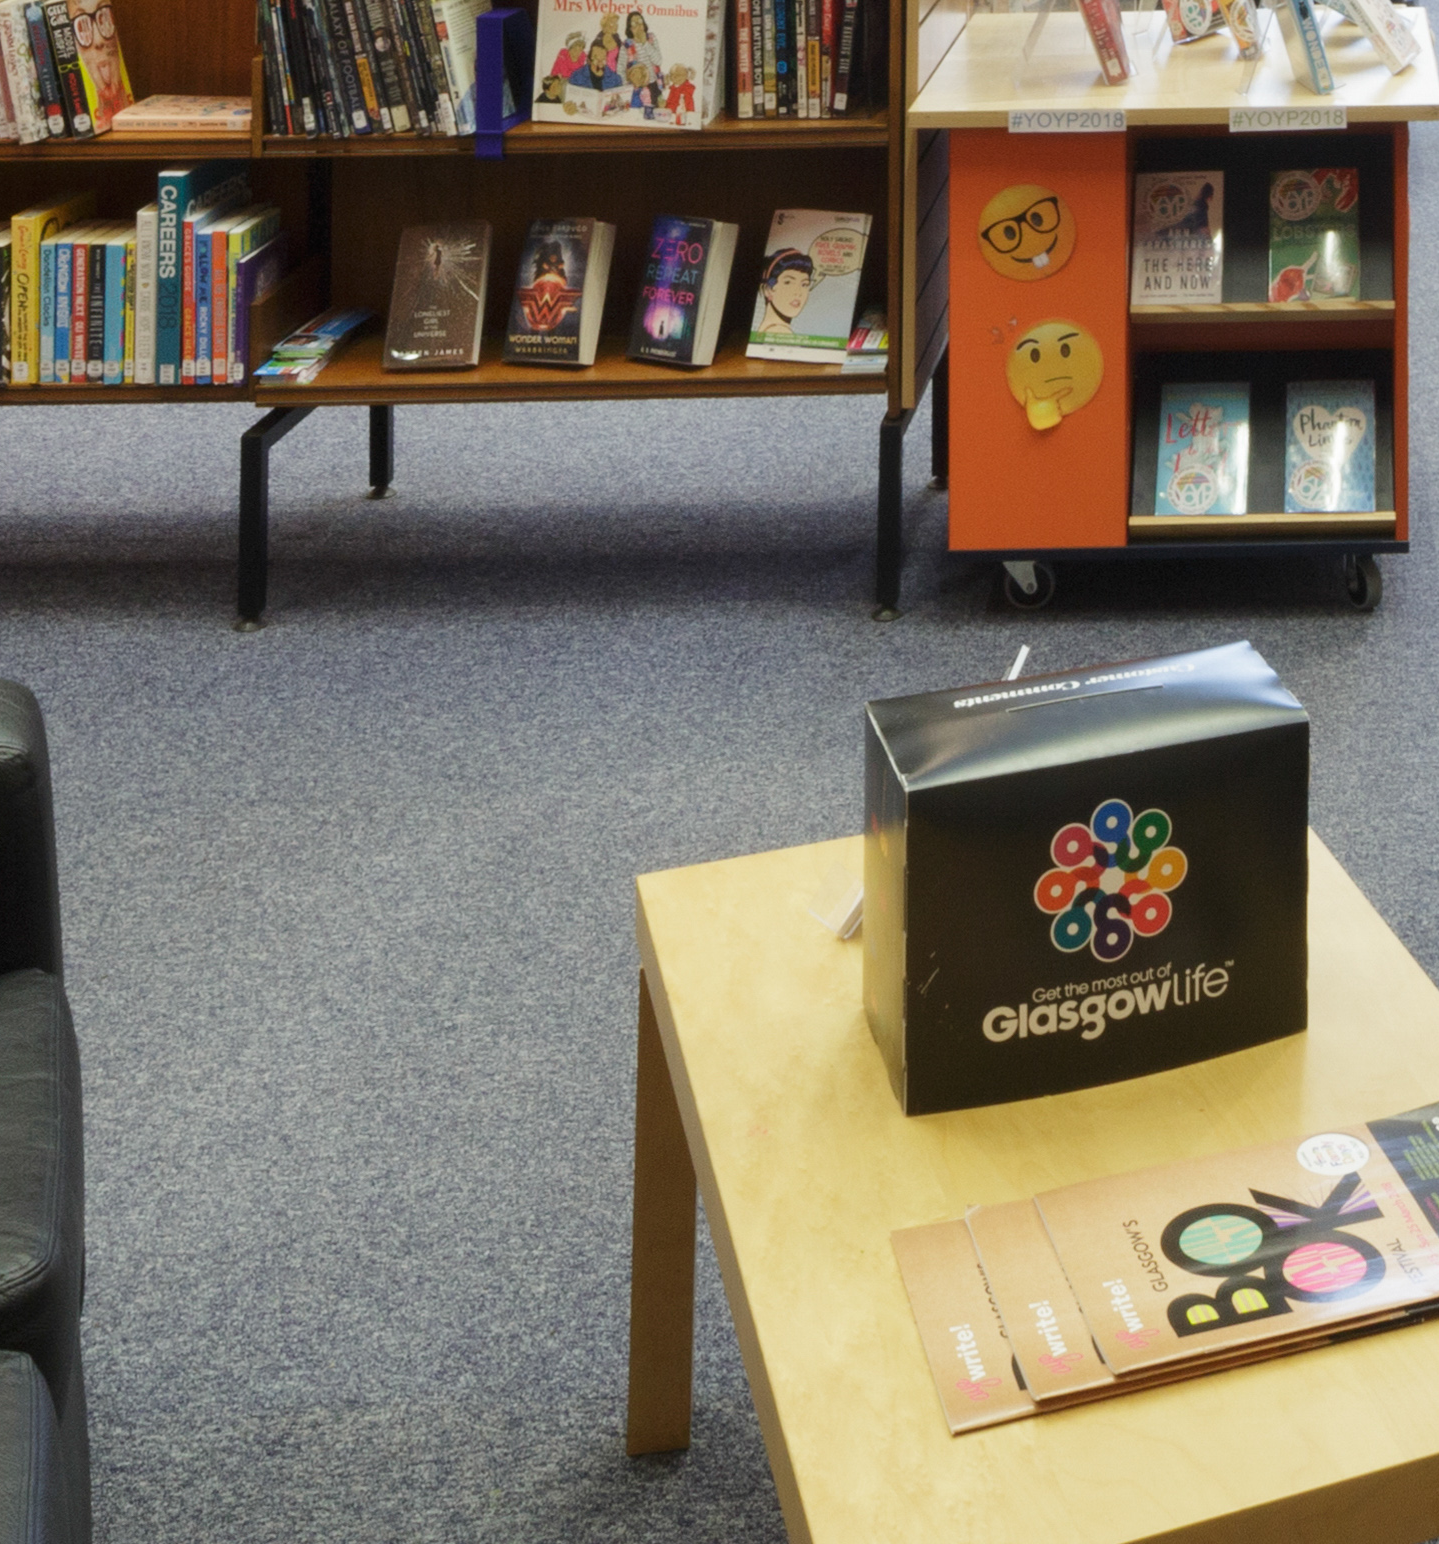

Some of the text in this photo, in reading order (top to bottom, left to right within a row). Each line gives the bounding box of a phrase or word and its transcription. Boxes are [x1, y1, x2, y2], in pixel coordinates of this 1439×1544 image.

[646, 3, 699, 18] Omnibus
[52, 29, 68, 60] MISFIT
[62, 26, 77, 59] MODEL
[336, 39, 349, 55] OF
[1297, 17, 1326, 79] WONDER
[341, 58, 362, 111] FOOTBAL
[1010, 111, 1125, 130] #YOYP2018
[1231, 109, 1345, 129] #YOYP2018
[159, 185, 179, 329] CAREERS 2018
[183, 228, 193, 292] GRACE'S GUIDE
[650, 237, 705, 265] ZERO
[1143, 256, 1215, 274] THE HERE
[42, 248, 52, 327] Dandelion Clocks
[74, 247, 86, 316] GENERATION NEXT
[645, 264, 698, 286] REPEAT
[1143, 274, 1211, 291] AND NOW
[642, 285, 696, 306] FOREVER
[413, 309, 451, 320] LONELIEST
[413, 329, 448, 339] UNIVERSE
[508, 334, 578, 346] WONDER WOMAN
[952, 662, 1196, 710] Customer Comments
[1032, 961, 1174, 1004] Get the most out of
[1122, 1218, 1170, 1294] GLASGOW'S
[1101, 1276, 1144, 1334] write!
[1028, 1299, 1068, 1358] write!
[948, 1322, 988, 1382] write!
